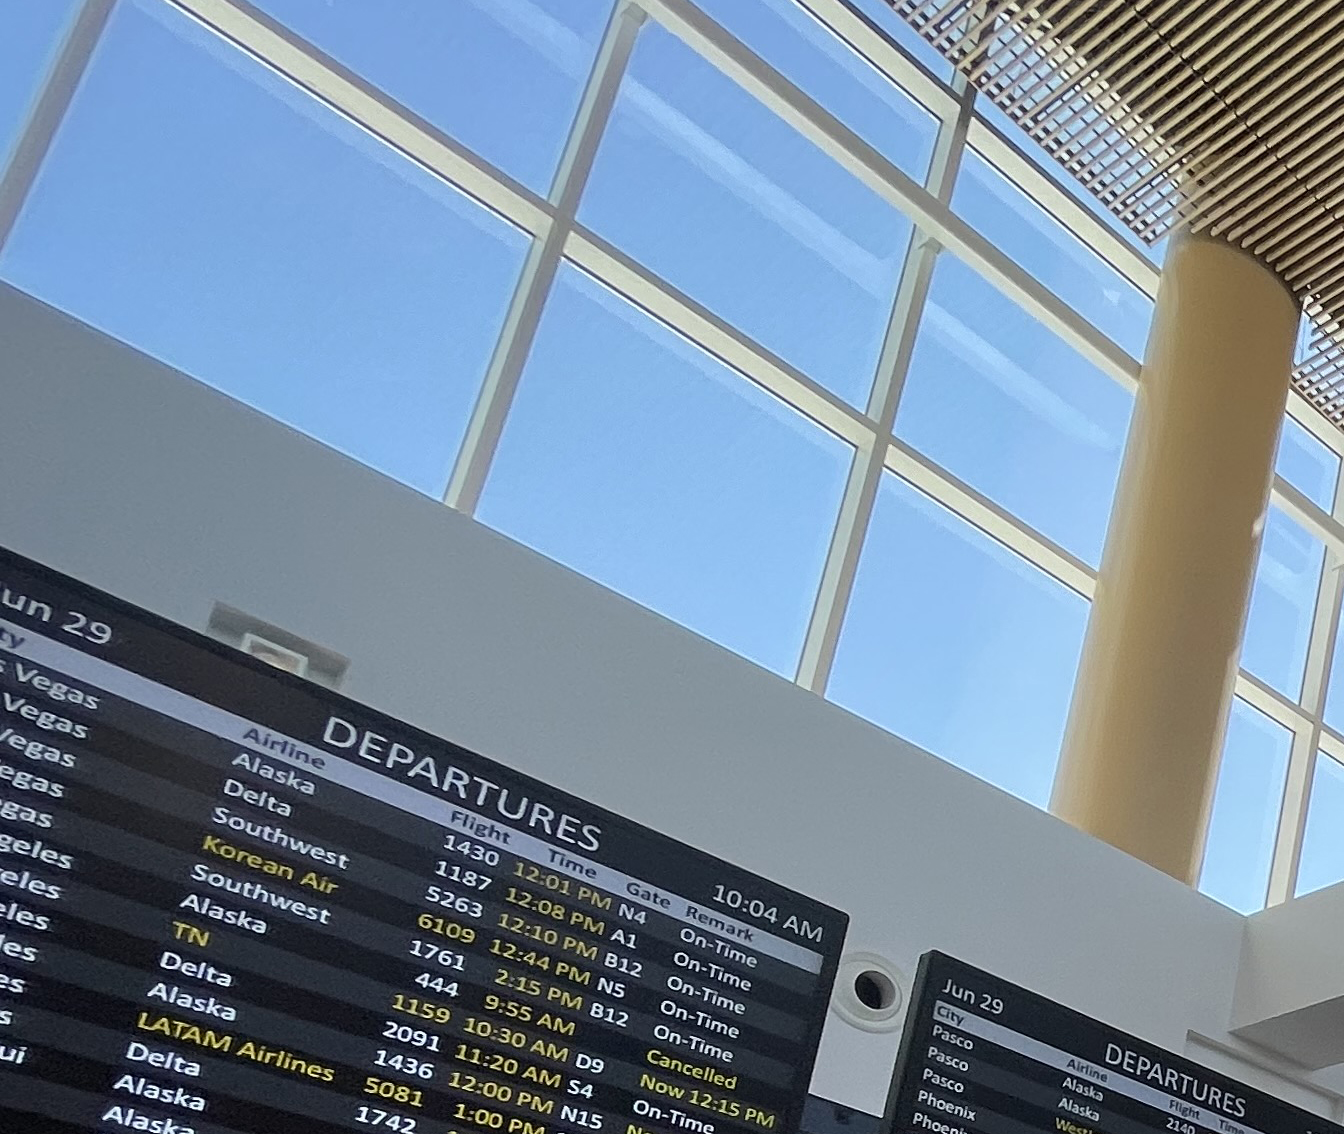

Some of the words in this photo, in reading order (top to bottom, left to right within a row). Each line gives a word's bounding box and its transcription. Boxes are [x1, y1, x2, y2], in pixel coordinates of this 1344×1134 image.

[61, 611, 112, 644] 29
[15, 662, 101, 710] Vegas
[231, 753, 314, 794] Alaska
[443, 834, 499, 866] 1430
[514, 862, 569, 895] 12:01
[577, 886, 611, 910] PM
[618, 903, 646, 924] N4
[680, 927, 757, 967] On-Time
[242, 728, 325, 769] Airline
[450, 810, 510, 844] Flight
[548, 848, 596, 878] Time
[626, 882, 670, 908] Gate
[685, 905, 750, 940] Remark
[322, 716, 601, 851] DEPARTURES
[202, 835, 293, 879] Korean
[299, 872, 338, 893] Air
[417, 913, 475, 943] 6109
[489, 938, 549, 970] 12:44
[555, 961, 590, 985] PM
[596, 976, 625, 998] N5
[660, 999, 739, 1038] On-Time
[712, 884, 777, 923] 10:04
[782, 915, 822, 942] AM
[172, 920, 209, 946] TN
[392, 994, 450, 1023] 1159
[463, 1017, 526, 1047] 10:30
[529, 1039, 568, 1062] AM
[575, 1053, 604, 1073] D9
[639, 1073, 685, 1098] Now
[688, 1090, 740, 1116] 12:15
[744, 1107, 774, 1128] PM
[179, 893, 267, 934] Alaska
[414, 972, 458, 997] 444
[484, 994, 532, 1021] 9:55
[535, 1012, 575, 1035] AM
[646, 1049, 737, 1089] Cancelled
[942, 978, 975, 1004] Jun
[979, 993, 1003, 1014] 29
[137, 1011, 232, 1052] LATAM
[235, 1041, 334, 1081] Airlines
[363, 1076, 422, 1107] 5081
[453, 1103, 503, 1128] 1:00
[932, 1024, 973, 1049] Pasco
[1061, 1076, 1103, 1101] Alaska
[936, 1005, 964, 1026] City
[1066, 1058, 1107, 1082] Airline
[1169, 1099, 1199, 1120] Flight
[1104, 1042, 1245, 1117] DEPARTURES
